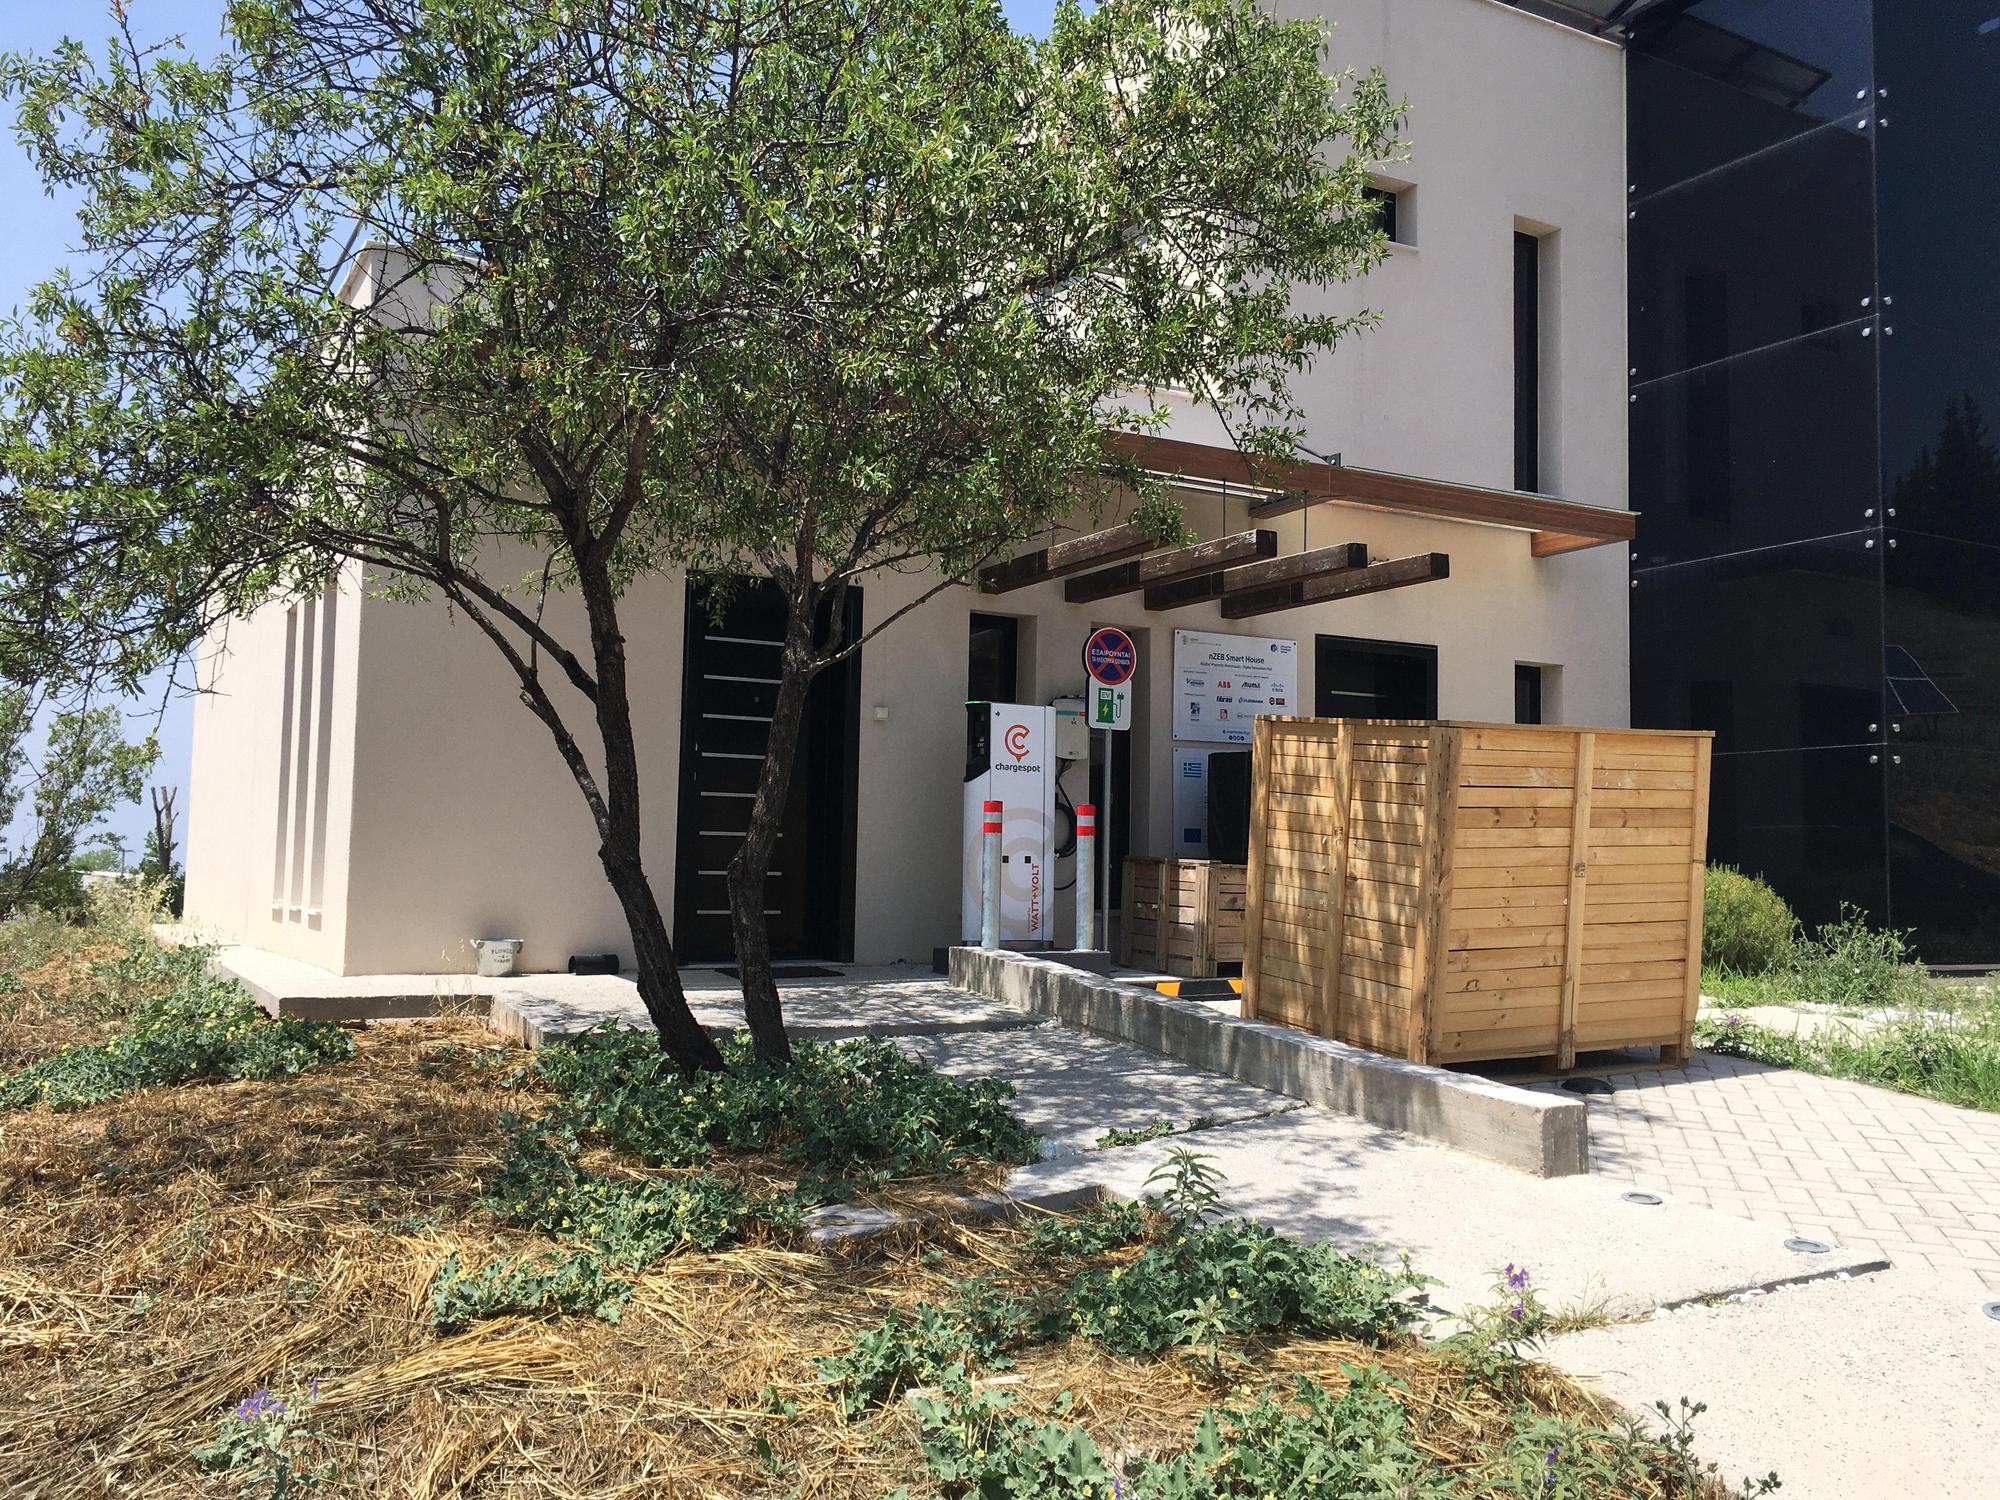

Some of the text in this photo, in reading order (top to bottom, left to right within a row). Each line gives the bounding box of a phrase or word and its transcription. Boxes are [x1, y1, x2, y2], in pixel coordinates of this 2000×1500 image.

[1091, 648, 1131, 659] ΕΞΑΙΡΟΥΝΤΑΙ
[1208, 652, 1265, 664] nZEB Smart House
[1217, 680, 1231, 689] ABB
[1101, 691, 1111, 699] EV
[995, 762, 1041, 773] chargespot
[1031, 863, 1040, 932] WATT+VOLT
